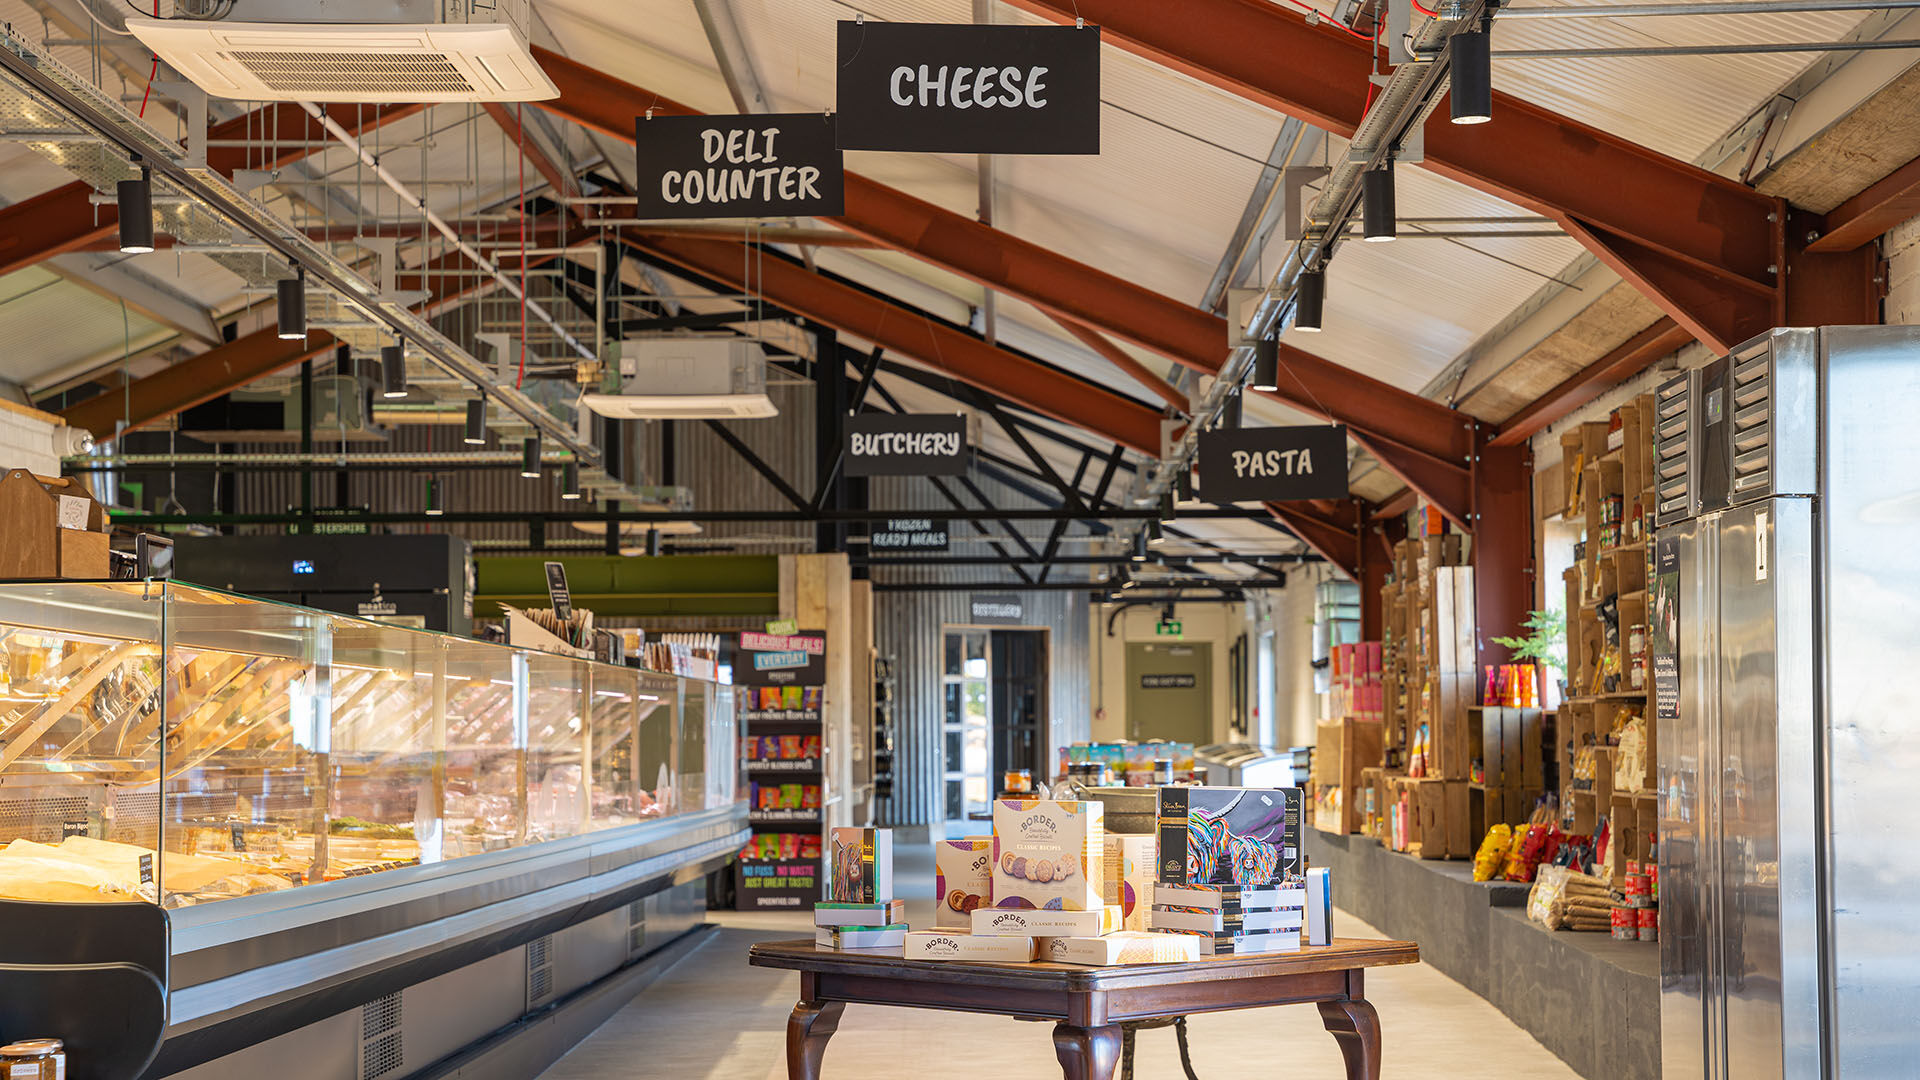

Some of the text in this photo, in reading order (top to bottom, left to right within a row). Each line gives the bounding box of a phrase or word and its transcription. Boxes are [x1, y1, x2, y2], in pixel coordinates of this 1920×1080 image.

[890, 65, 1048, 109] CHEESE
[701, 128, 780, 164] DELI
[661, 166, 822, 204] COUNTER
[850, 431, 960, 457] BUTCHERY
[1231, 448, 1313, 478] PASTA
[873, 532, 946, 546] READY MEALS
[757, 653, 804, 669] EVERYDAY
[1022, 814, 1056, 832] BORDER
[742, 866, 752, 877] NO
[777, 866, 788, 877] NO
[744, 877, 762, 888] JUST
[763, 877, 786, 888] GREAT
[994, 914, 1026, 927] BORDER
[926, 937, 958, 951] BORDER
[1050, 939, 1068, 952] BORDER
